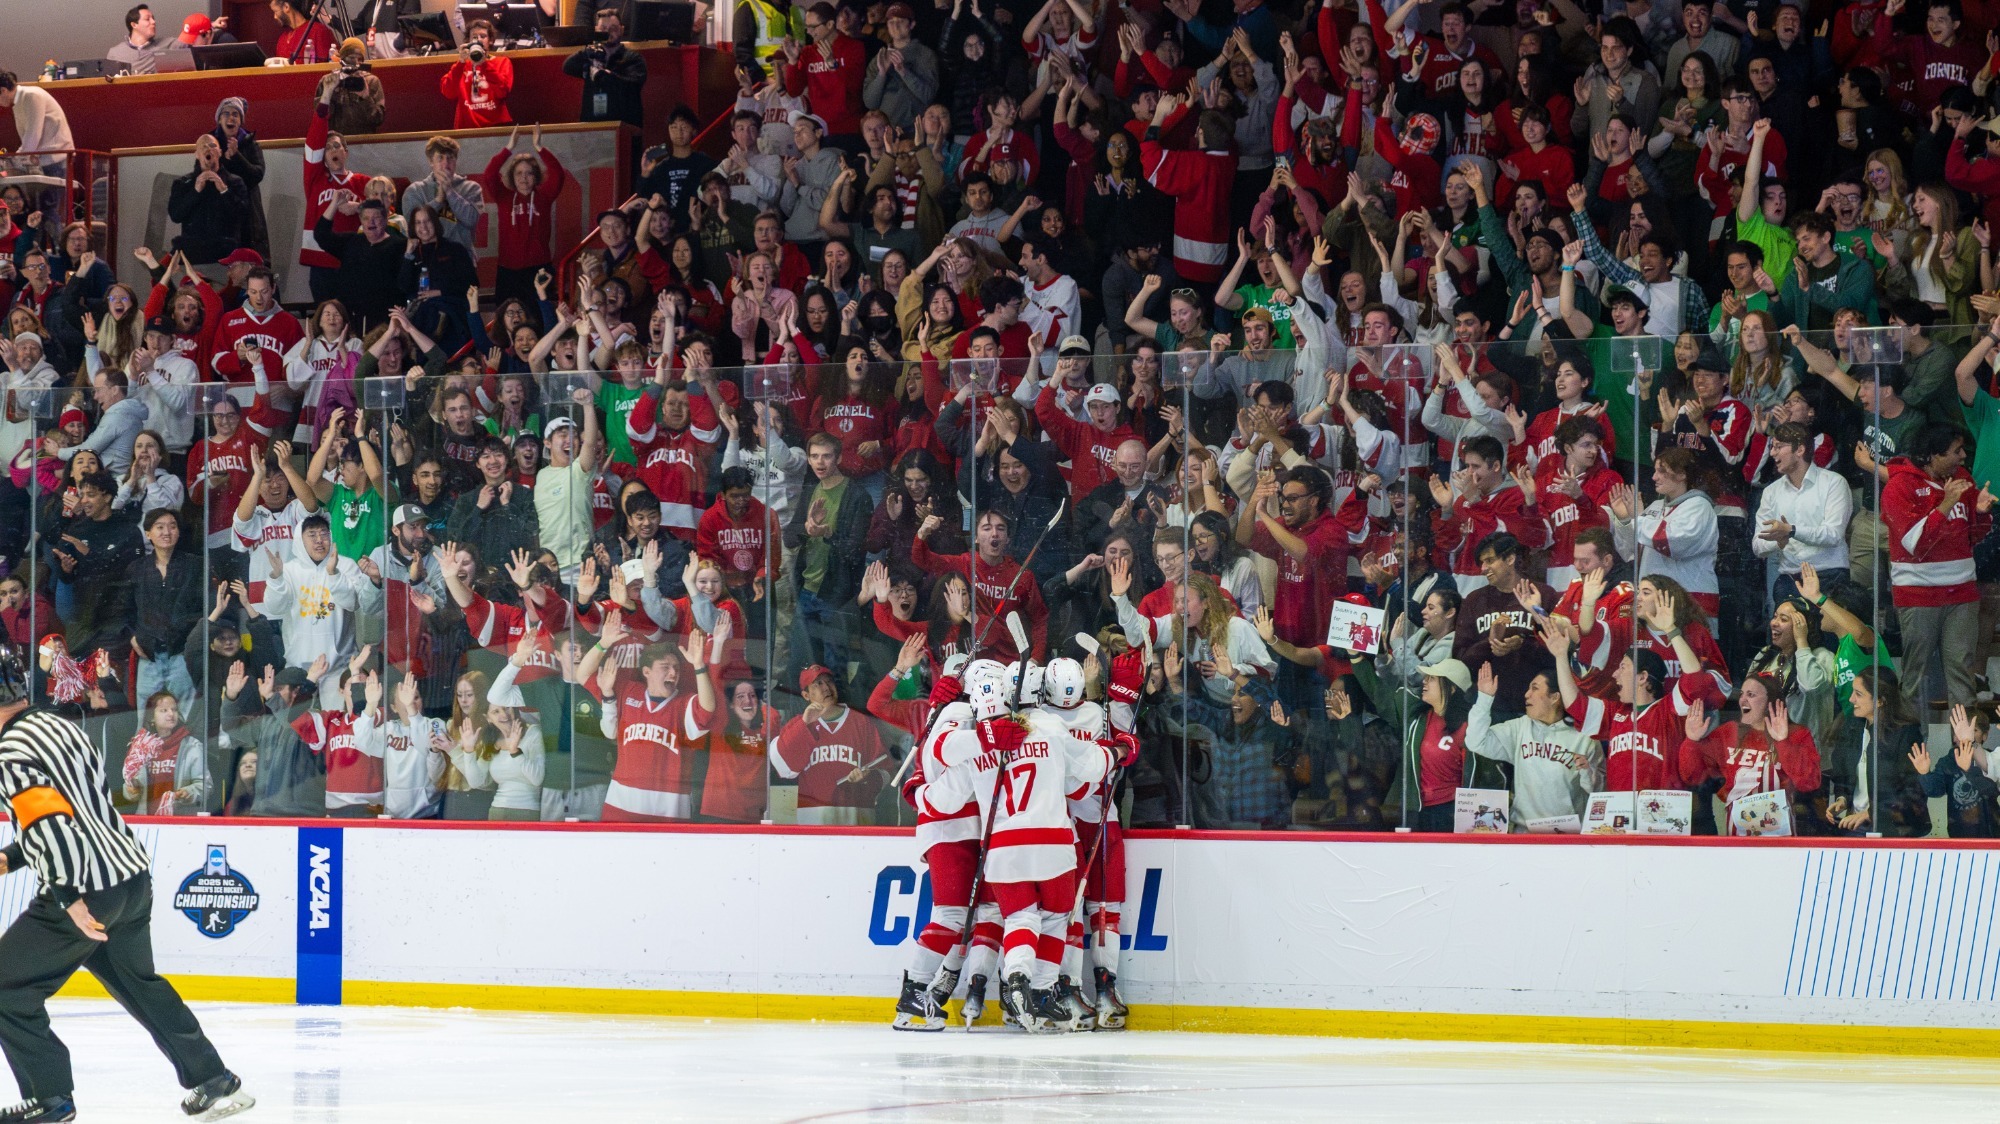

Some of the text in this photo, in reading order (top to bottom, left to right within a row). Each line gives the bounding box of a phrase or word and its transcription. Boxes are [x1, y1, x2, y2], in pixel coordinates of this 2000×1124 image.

[1001, 145, 1009, 153] C
[1094, 386, 1103, 394] C
[824, 404, 874, 420] CORNELL
[646, 447, 697, 473] CORNELL
[987, 704, 996, 714] 17
[623, 722, 679, 756] CORNELL
[1437, 735, 1454, 751] C
[973, 751, 999, 773] VAN
[1521, 741, 1574, 770] CORNELL
[1000, 762, 1036, 818] 17
[1743, 793, 1769, 804] SUITCASE
[189, 885, 213, 893] WOMEN'S
[224, 886, 244, 894] HOCKEY
[309, 844, 330, 930] NCAA
[175, 893, 258, 909] CHAMPIONSHIP
